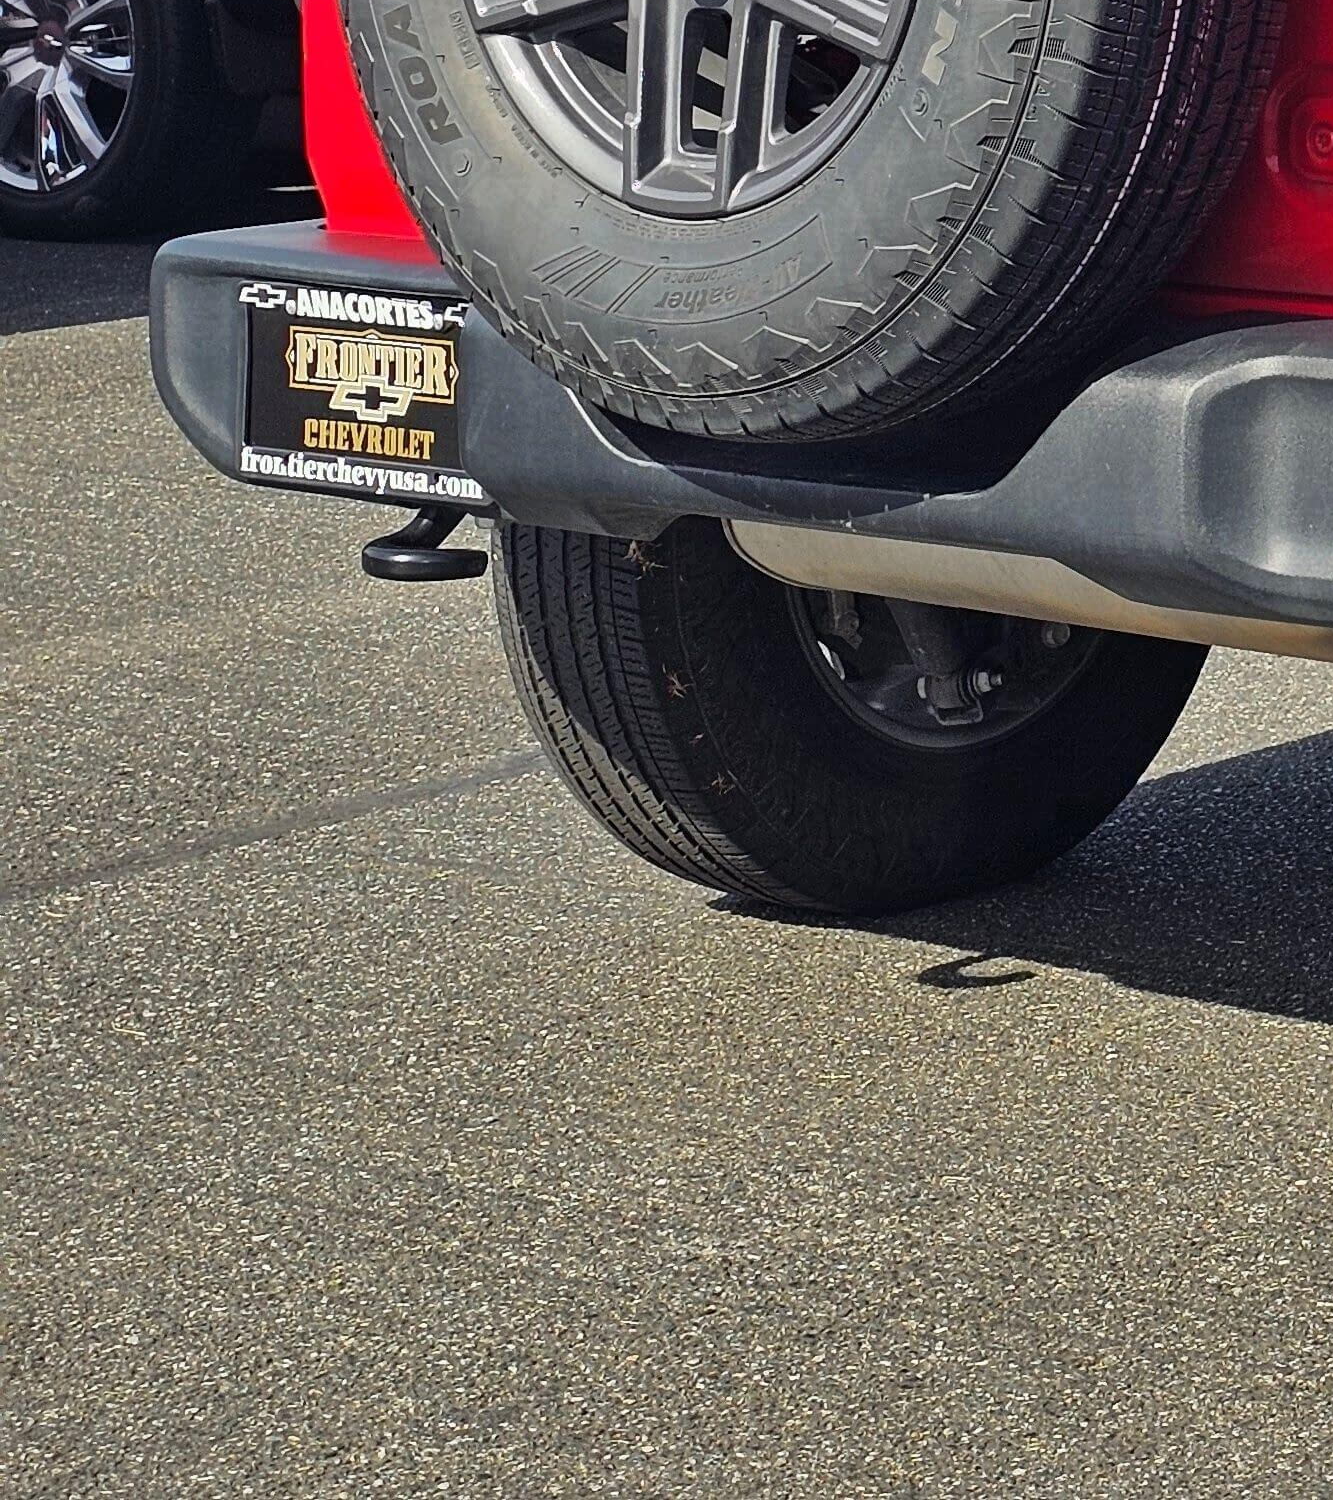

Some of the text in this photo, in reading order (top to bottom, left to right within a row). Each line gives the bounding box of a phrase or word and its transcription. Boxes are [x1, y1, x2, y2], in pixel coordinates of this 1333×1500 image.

[295, 288, 435, 329] ANACORTES
[295, 332, 450, 396] FRONTIER
[304, 418, 435, 460] CHEVROLET
[240, 446, 483, 500] frontierchevyusa.com
